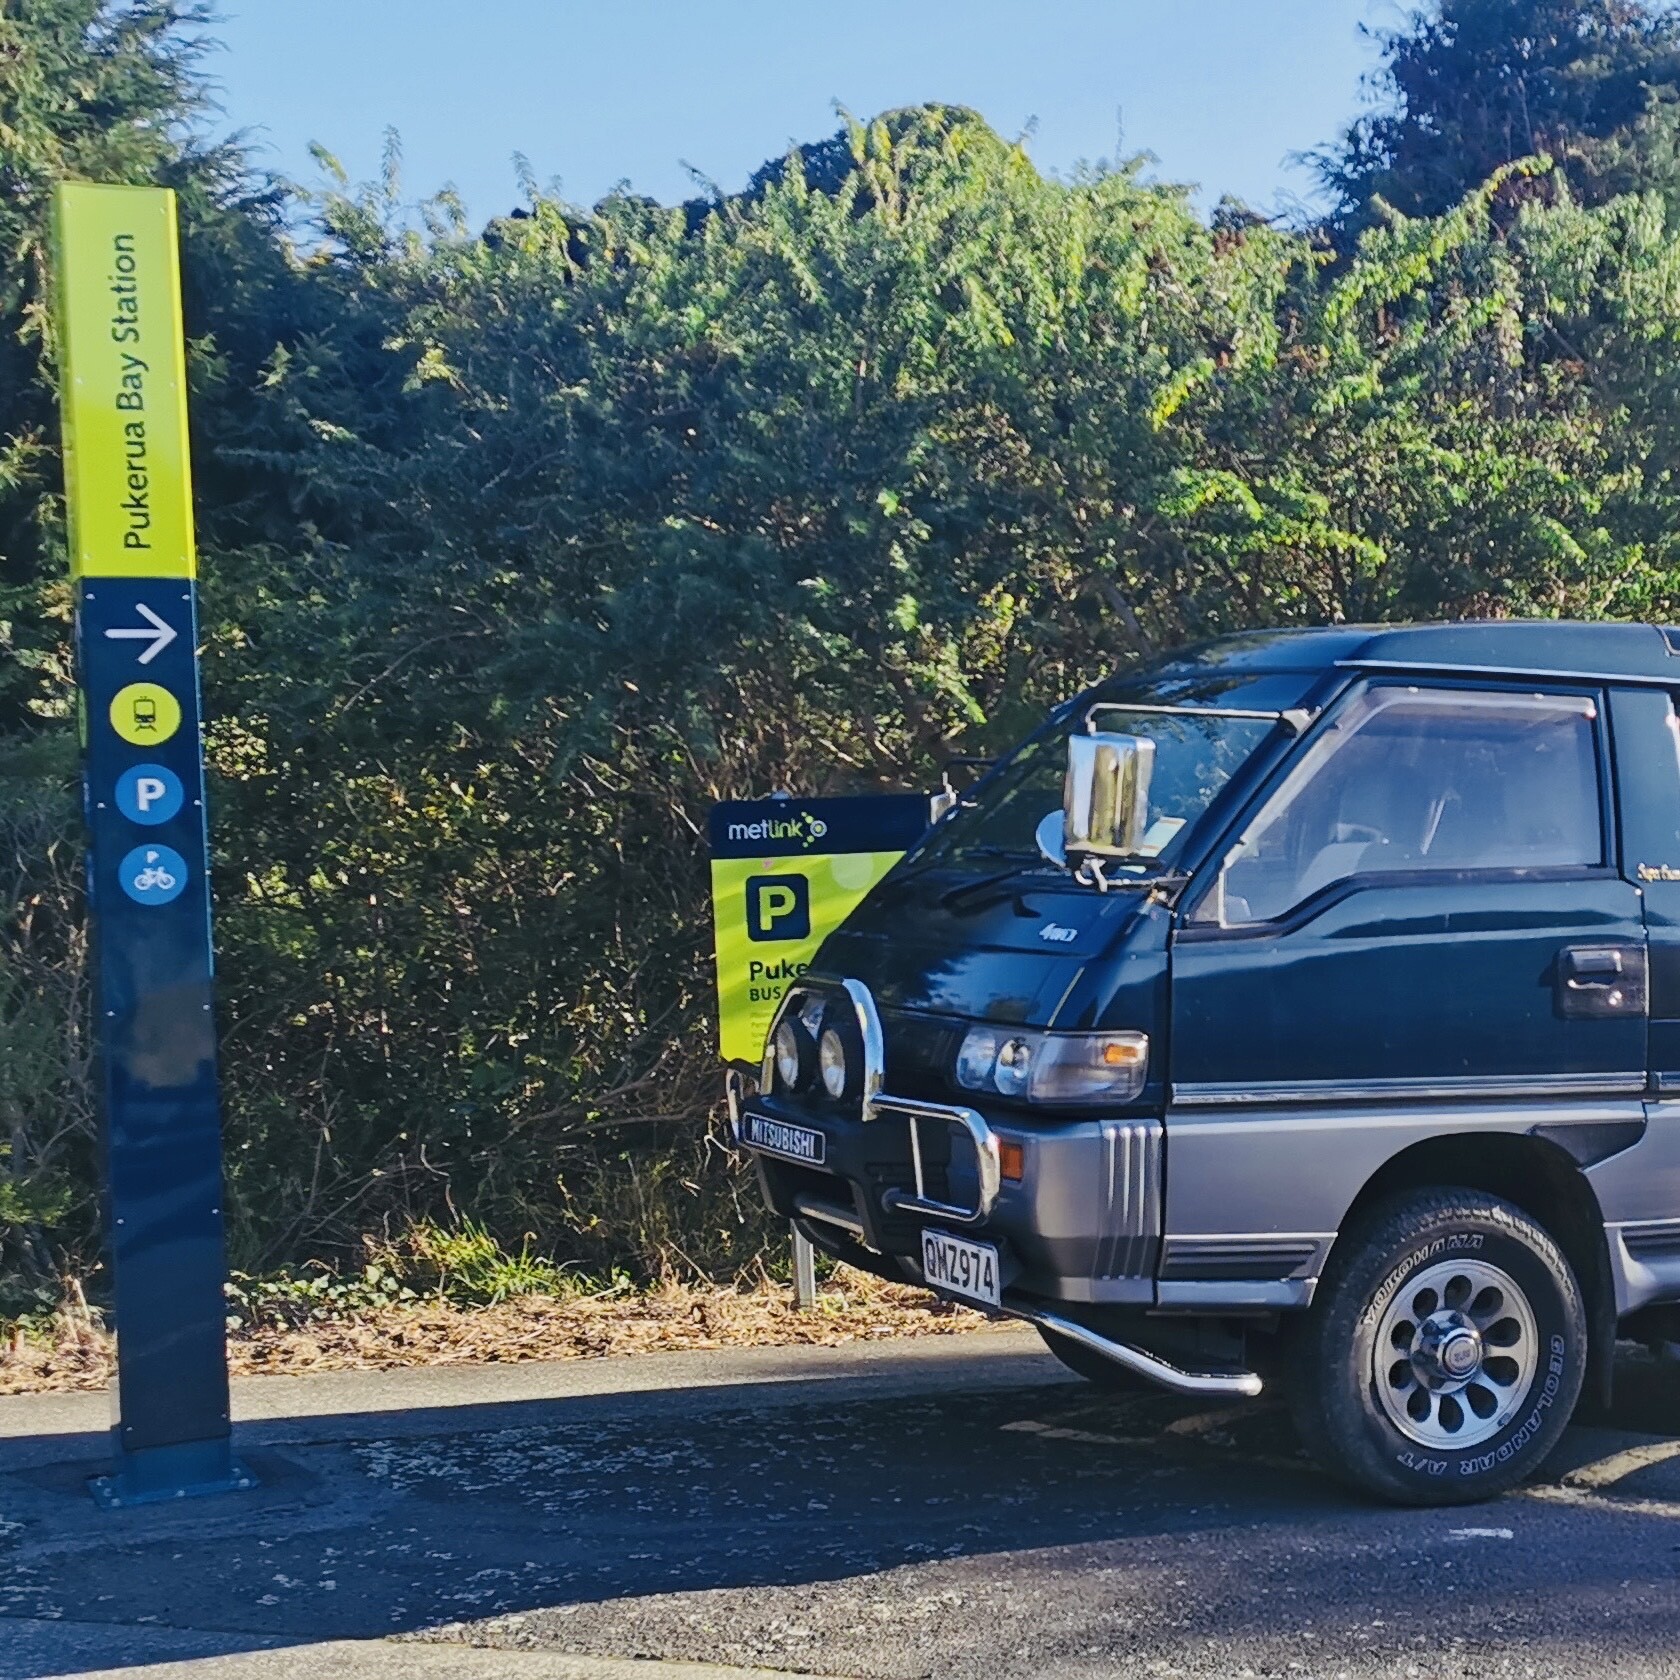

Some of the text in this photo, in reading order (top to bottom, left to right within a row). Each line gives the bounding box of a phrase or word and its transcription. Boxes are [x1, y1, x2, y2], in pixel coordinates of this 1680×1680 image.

[107, 233, 152, 550] Pukerua Bay Station
[137, 777, 166, 811] P
[728, 818, 803, 840] metlink
[758, 885, 797, 931] P
[749, 986, 781, 1002] BUS
[751, 1118, 816, 1158] MITSUBISHI
[1363, 1233, 1485, 1325] YOKOHAMA
[1396, 1333, 1566, 1476] GEOLANDAR A/T
